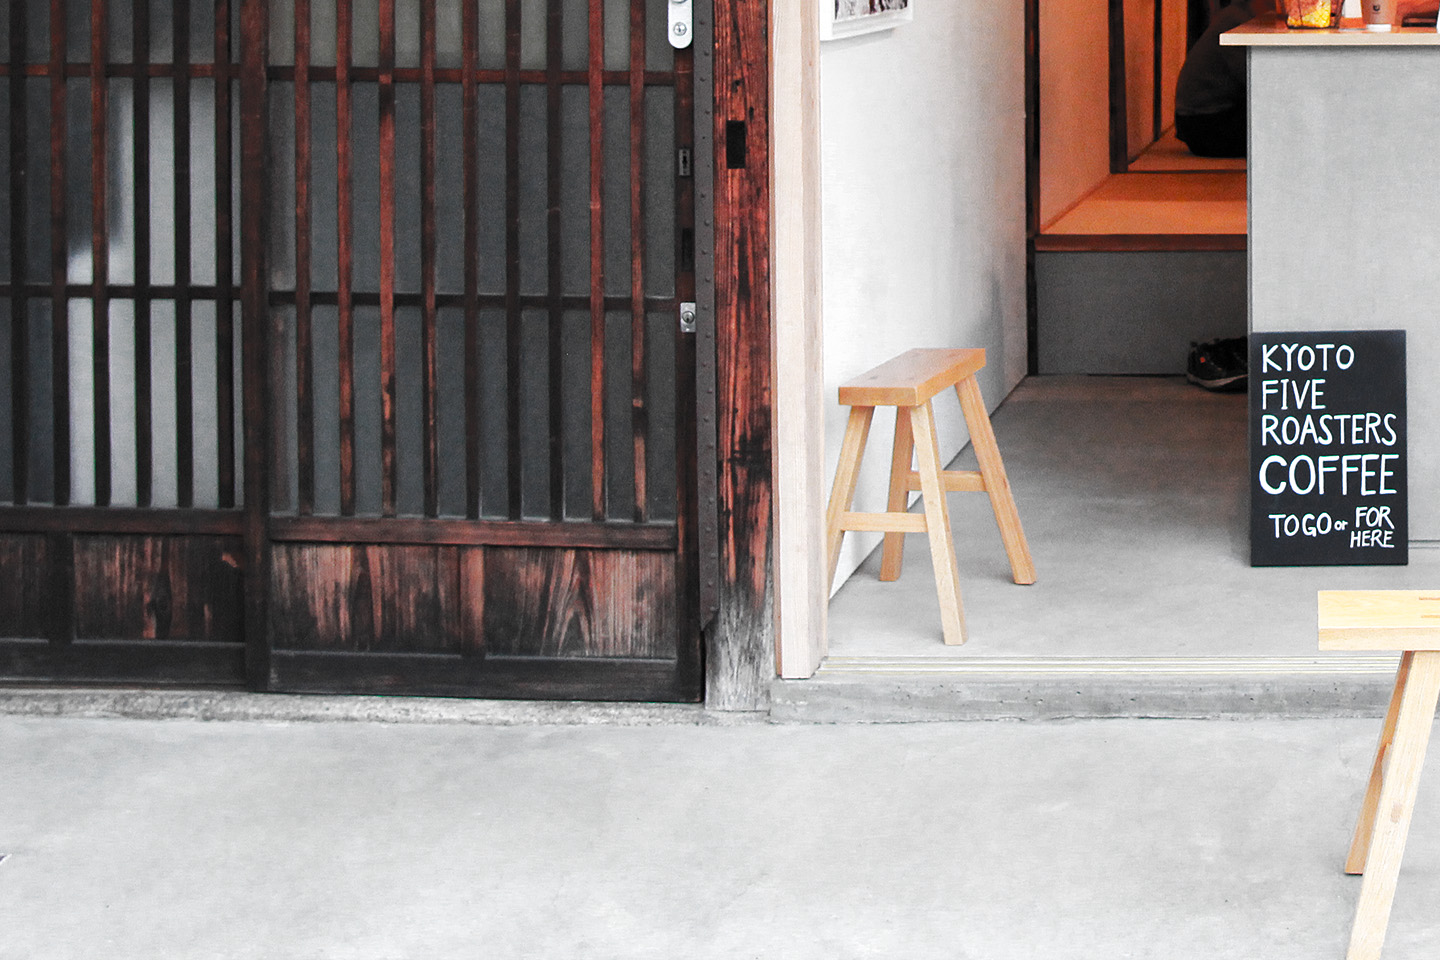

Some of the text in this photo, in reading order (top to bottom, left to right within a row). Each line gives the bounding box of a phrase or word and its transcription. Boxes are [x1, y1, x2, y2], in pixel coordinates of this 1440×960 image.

[1262, 343, 1355, 374] KYOTO
[1262, 378, 1326, 410] FIVE
[1262, 413, 1397, 446] ROASTERS
[1259, 454, 1400, 495] COFFEE
[1334, 518, 1348, 532] or
[1355, 506, 1395, 530] FOR
[1350, 530, 1394, 548] HERE
